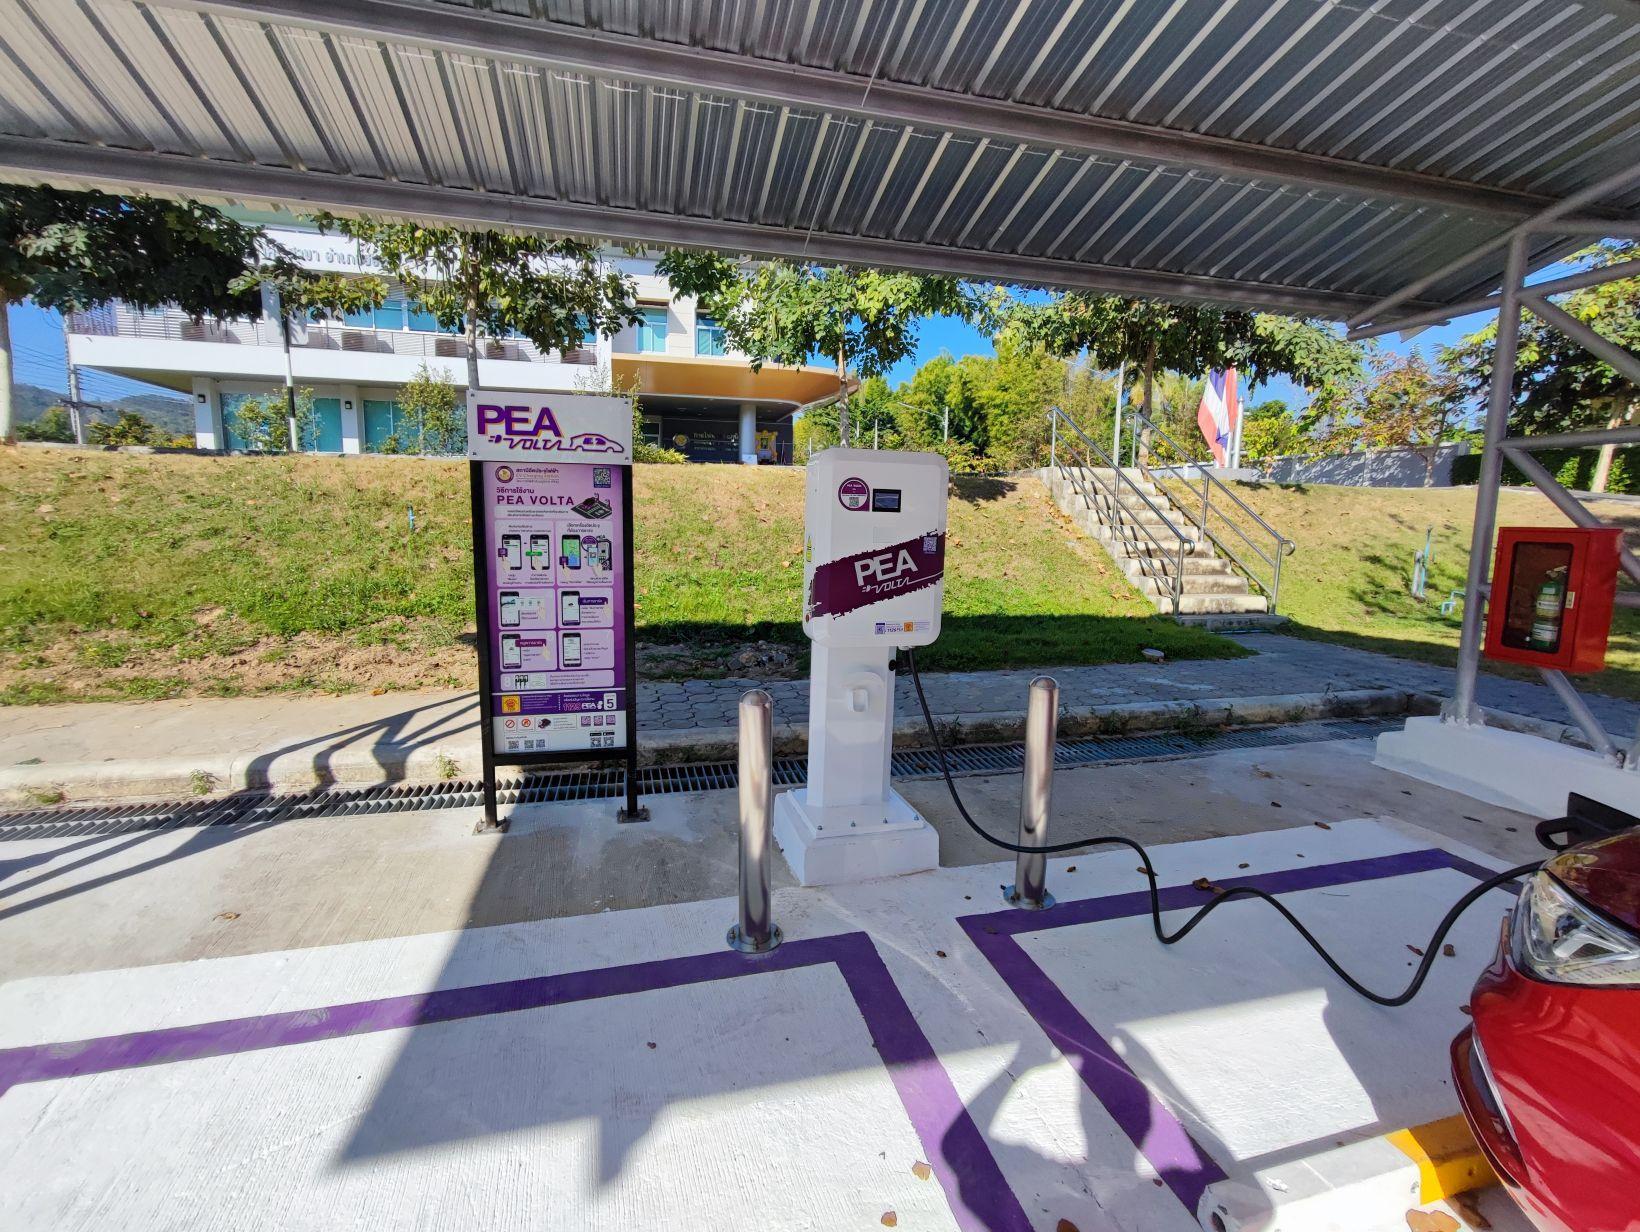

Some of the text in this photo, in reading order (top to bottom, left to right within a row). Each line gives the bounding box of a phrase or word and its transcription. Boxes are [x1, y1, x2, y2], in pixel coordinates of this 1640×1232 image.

[477, 404, 563, 437] PEA
[503, 438, 562, 450] VOLTA
[497, 495, 575, 506] PEA VOLTA
[854, 550, 918, 586] PEA
[871, 577, 910, 593] VOLTA
[607, 698, 615, 709] 5
